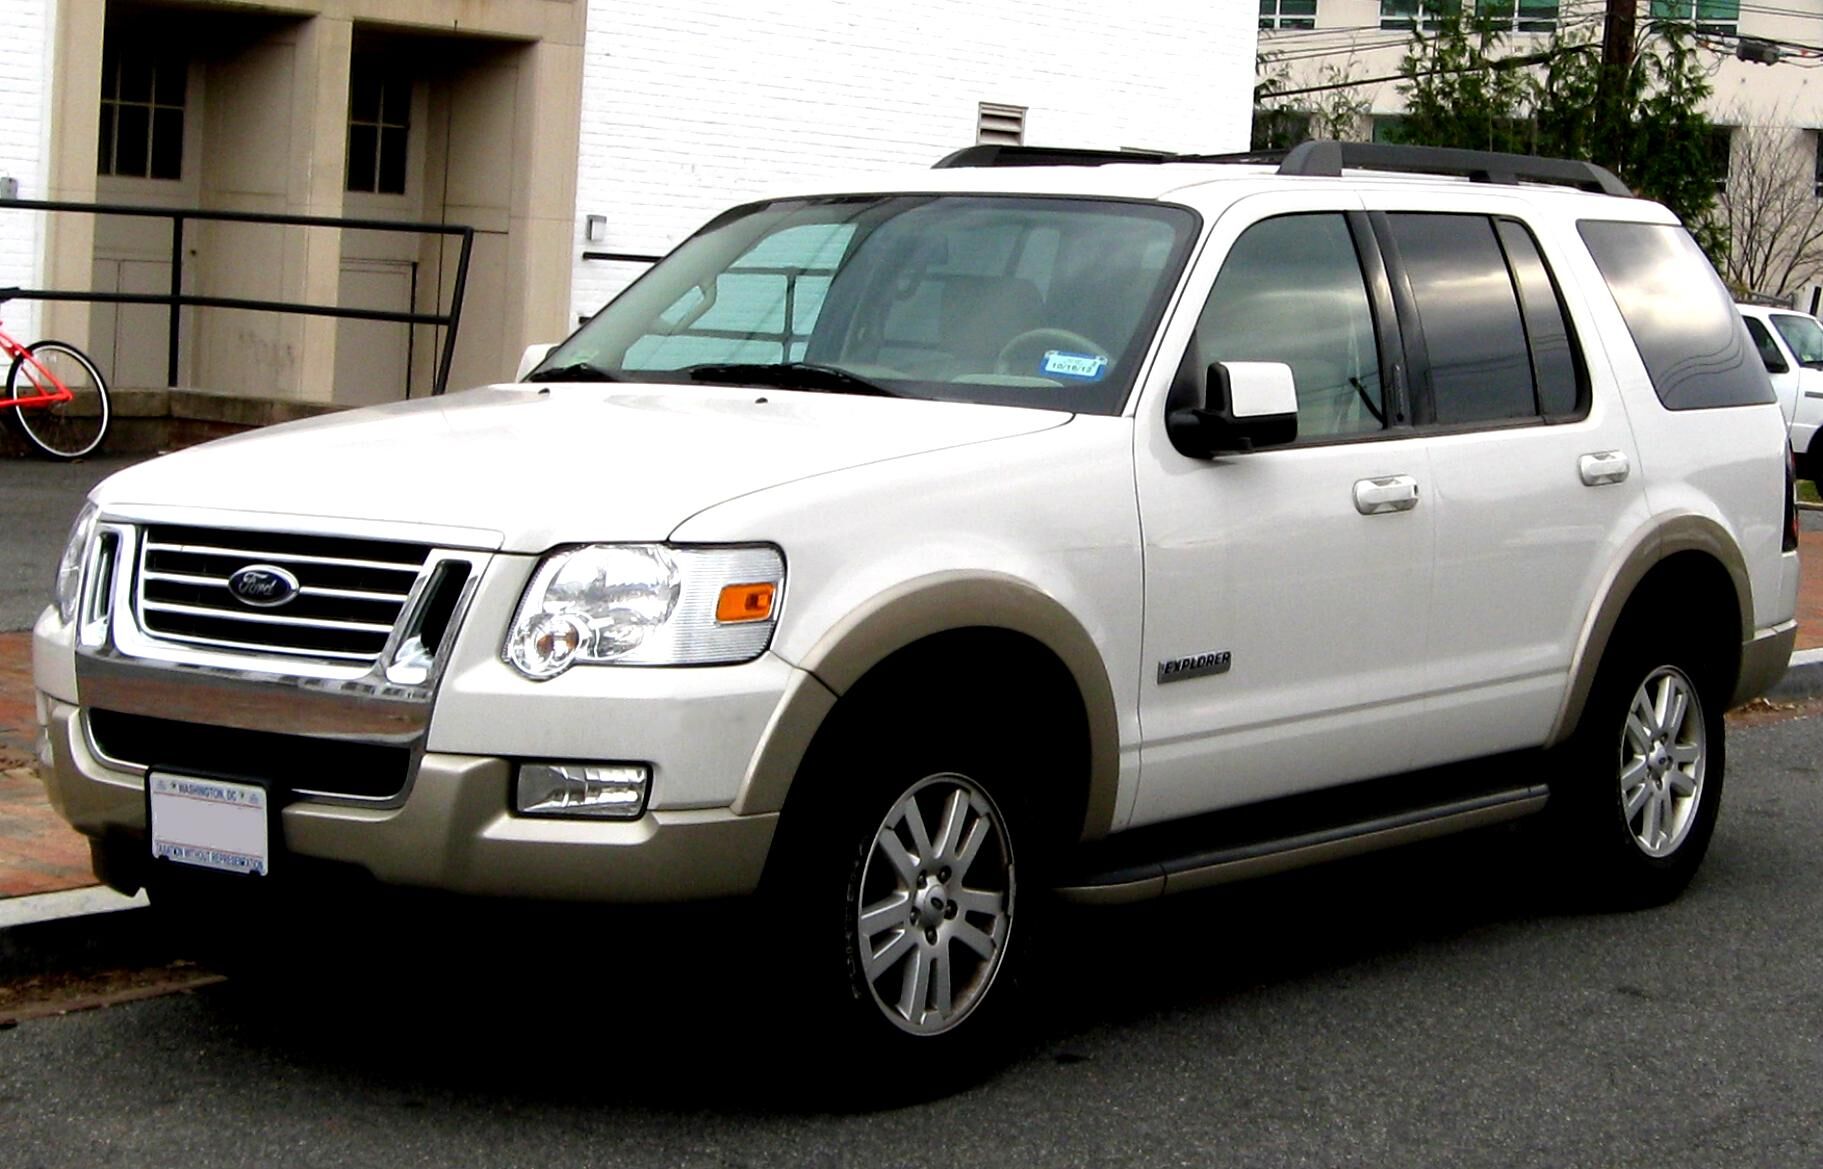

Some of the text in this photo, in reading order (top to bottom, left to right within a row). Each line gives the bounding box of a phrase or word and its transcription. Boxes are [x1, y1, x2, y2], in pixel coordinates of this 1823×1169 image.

[238, 571, 278, 596] Ford
[1164, 650, 1231, 674] EXPLORER
[227, 789, 237, 802] DC
